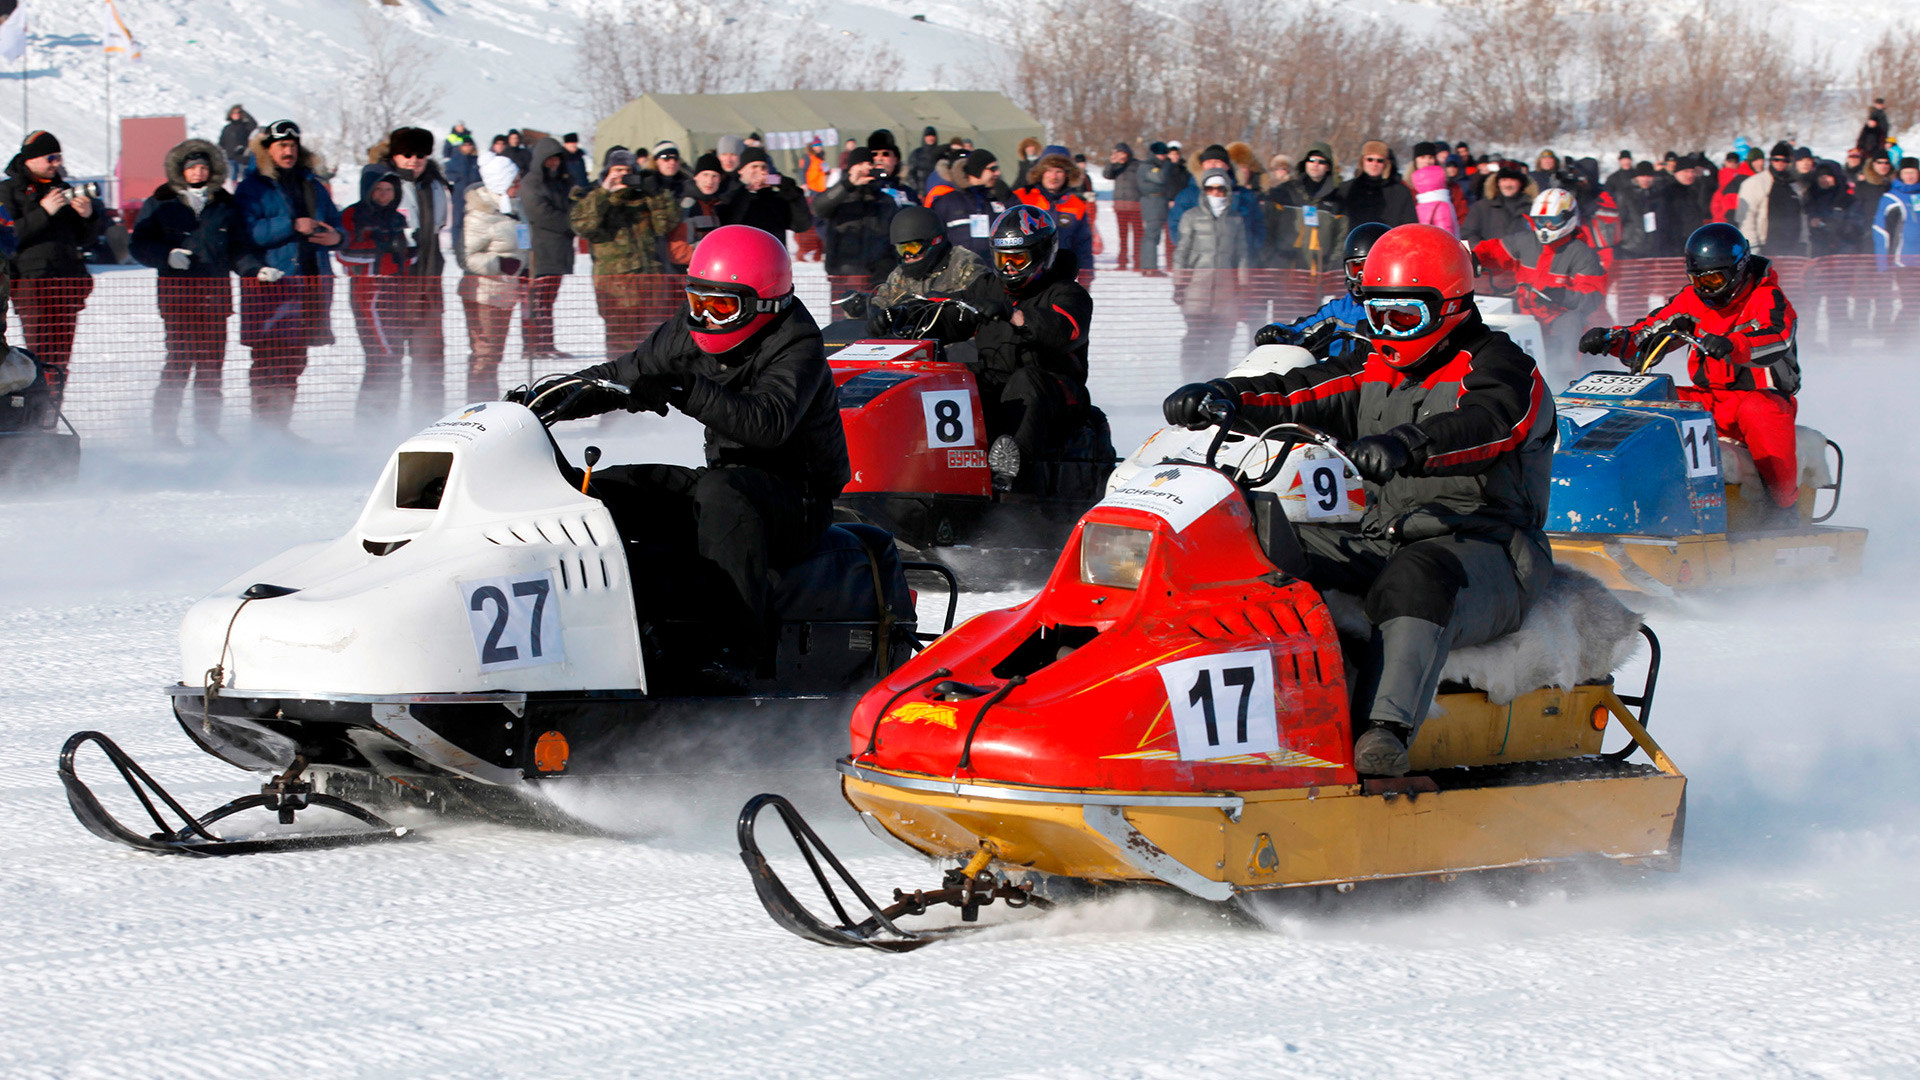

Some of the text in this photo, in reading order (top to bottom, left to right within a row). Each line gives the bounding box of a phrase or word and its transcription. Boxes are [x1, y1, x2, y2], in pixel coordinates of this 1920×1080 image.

[1590, 375, 1645, 385] 3398
[934, 399, 964, 443] 8
[947, 450, 987, 468] БУРАН
[1684, 425, 1717, 469] 11
[1312, 466, 1338, 511] 9
[471, 579, 550, 665] 27
[1188, 666, 1255, 747] 17
